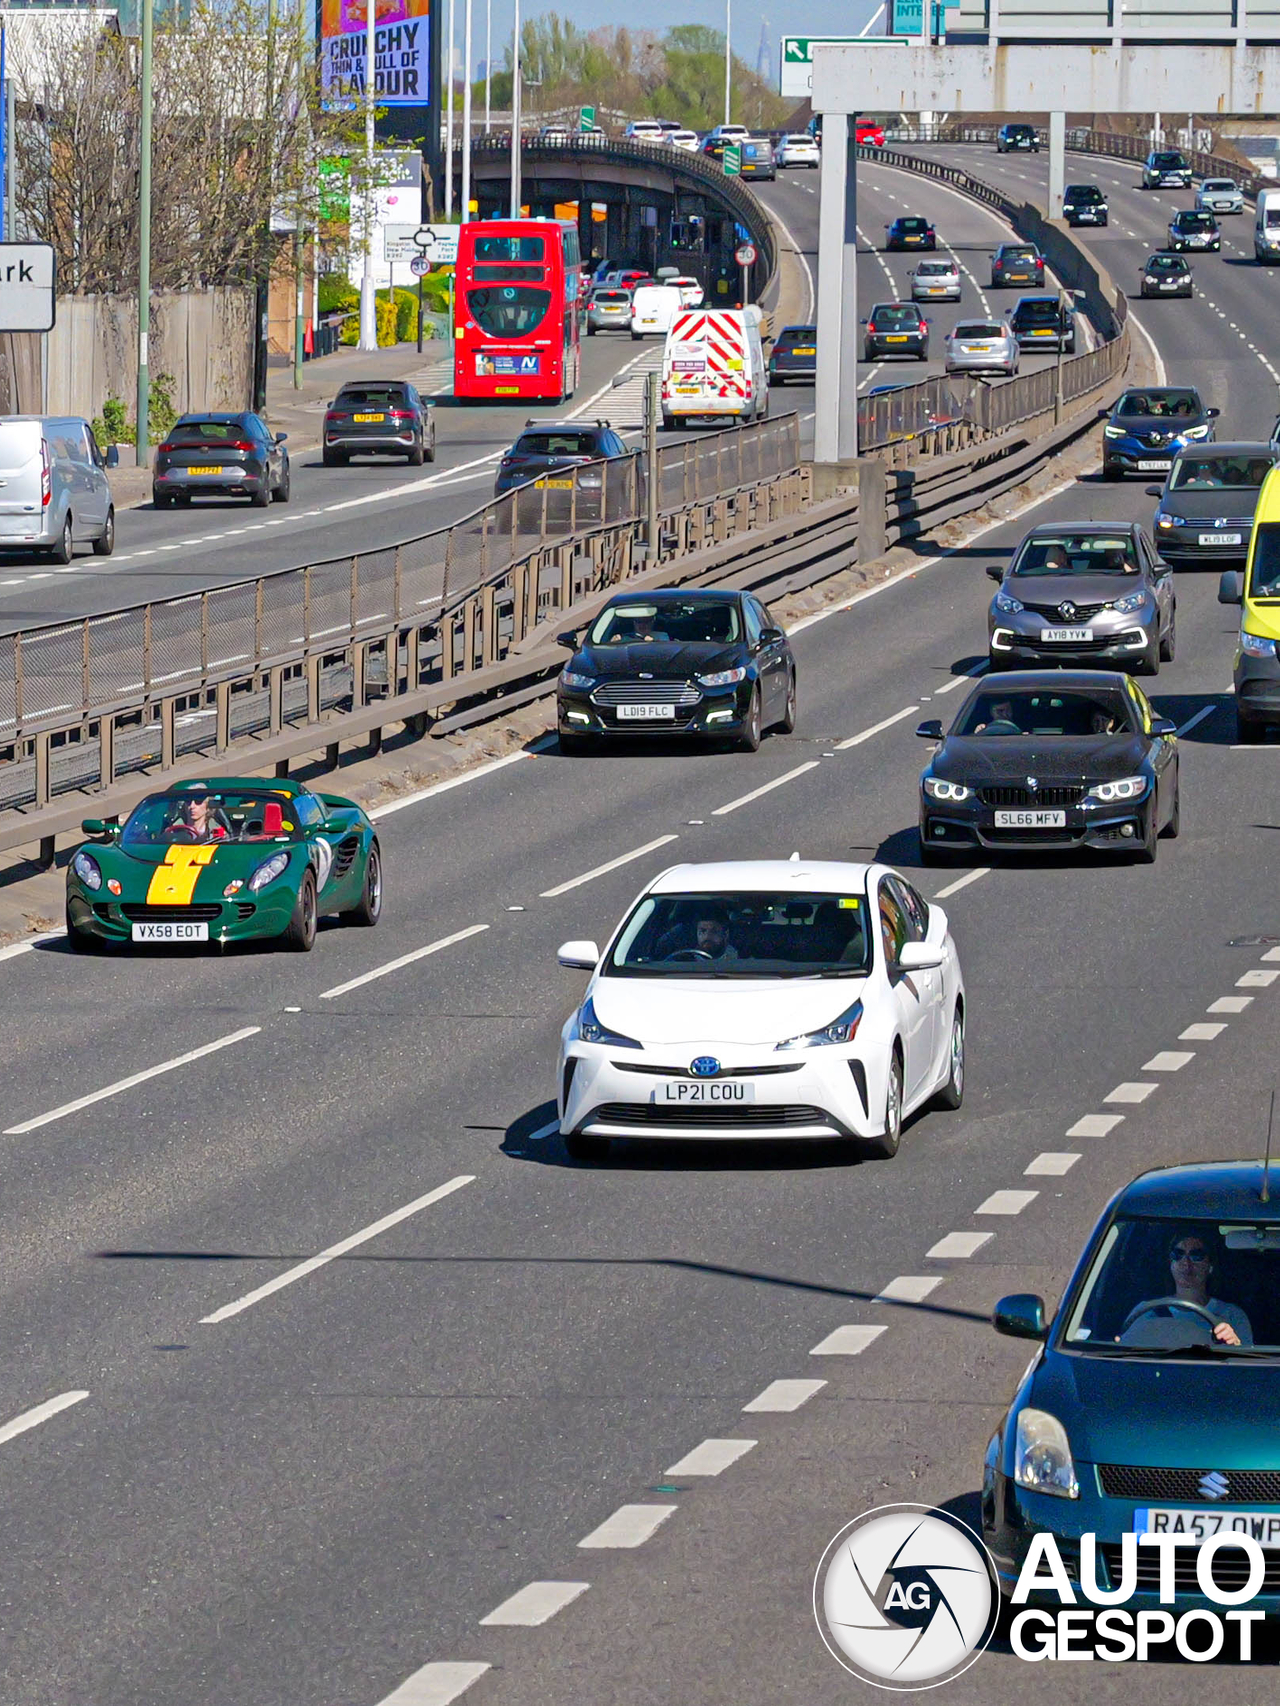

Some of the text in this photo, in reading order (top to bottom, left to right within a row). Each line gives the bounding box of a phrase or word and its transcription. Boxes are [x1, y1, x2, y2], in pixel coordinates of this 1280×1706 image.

[331, 50, 420, 75] THIN & ULL OF
[414, 261, 428, 271] 30
[1047, 630, 1067, 639] AY18
[623, 706, 668, 716] LD19 FLC
[1001, 813, 1060, 825] SL66 MFV
[139, 925, 202, 938] VX58 EOT
[666, 1084, 744, 1100] LP21 COU
[1154, 1513, 1224, 1538] RA57
